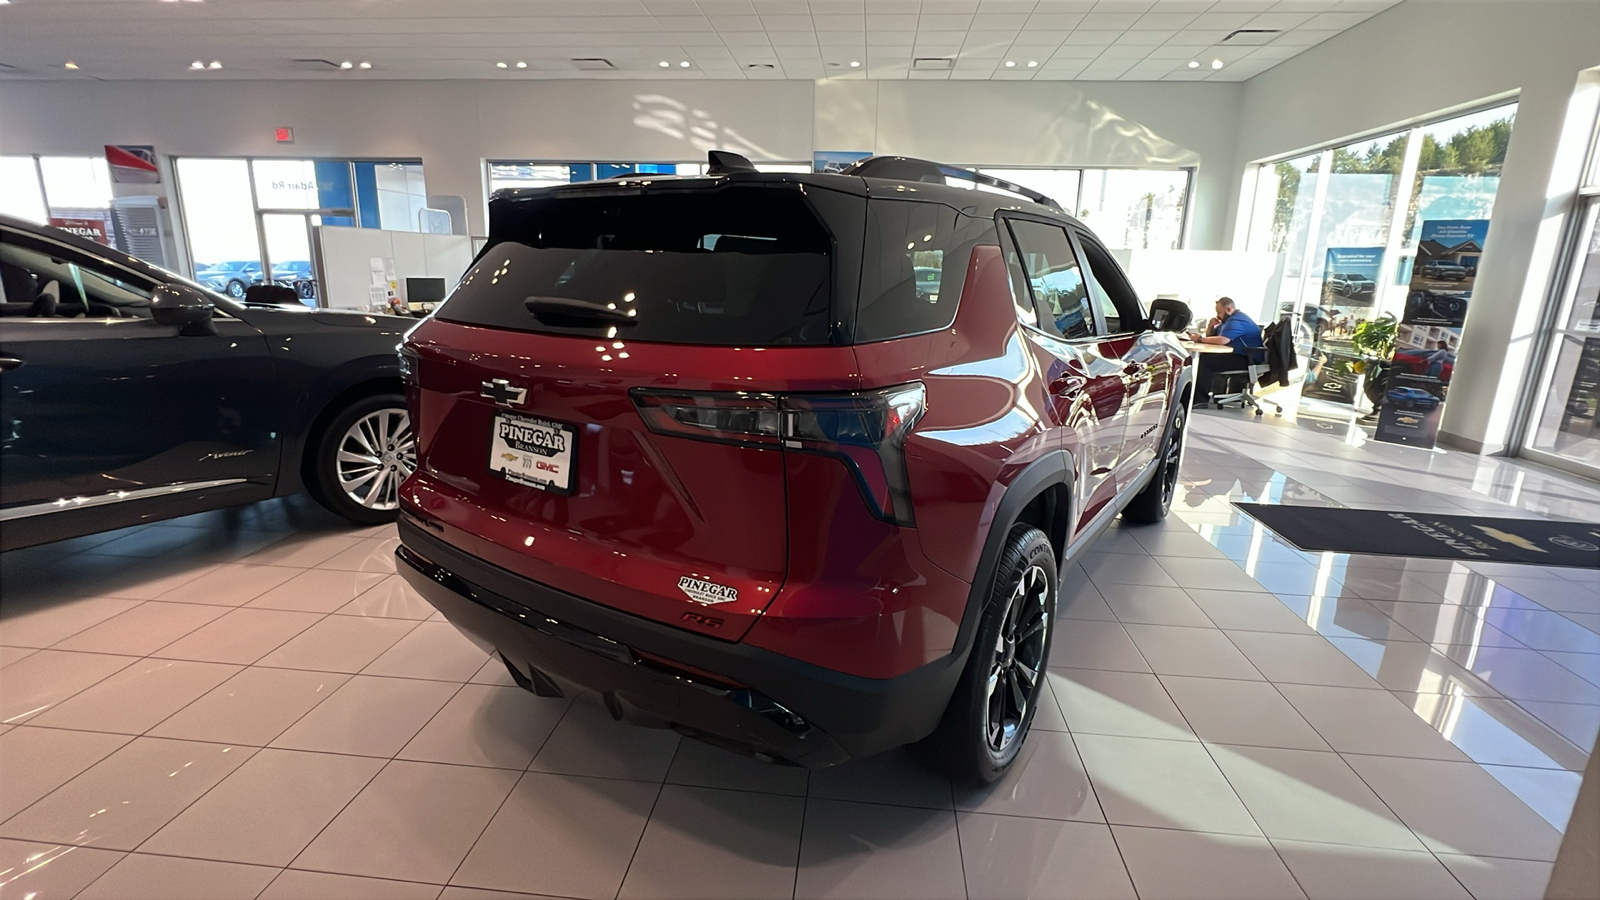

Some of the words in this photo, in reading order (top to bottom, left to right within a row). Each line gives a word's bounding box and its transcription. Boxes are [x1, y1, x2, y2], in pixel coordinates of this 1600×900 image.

[56, 226, 102, 237] NEGAR
[500, 424, 564, 451] PINEGAR
[536, 460, 560, 474] GMC
[1388, 513, 1490, 557] PINEGAR
[679, 577, 736, 600] PINEGAR
[692, 594, 714, 603] BRANSON
[681, 611, 724, 628] RS
